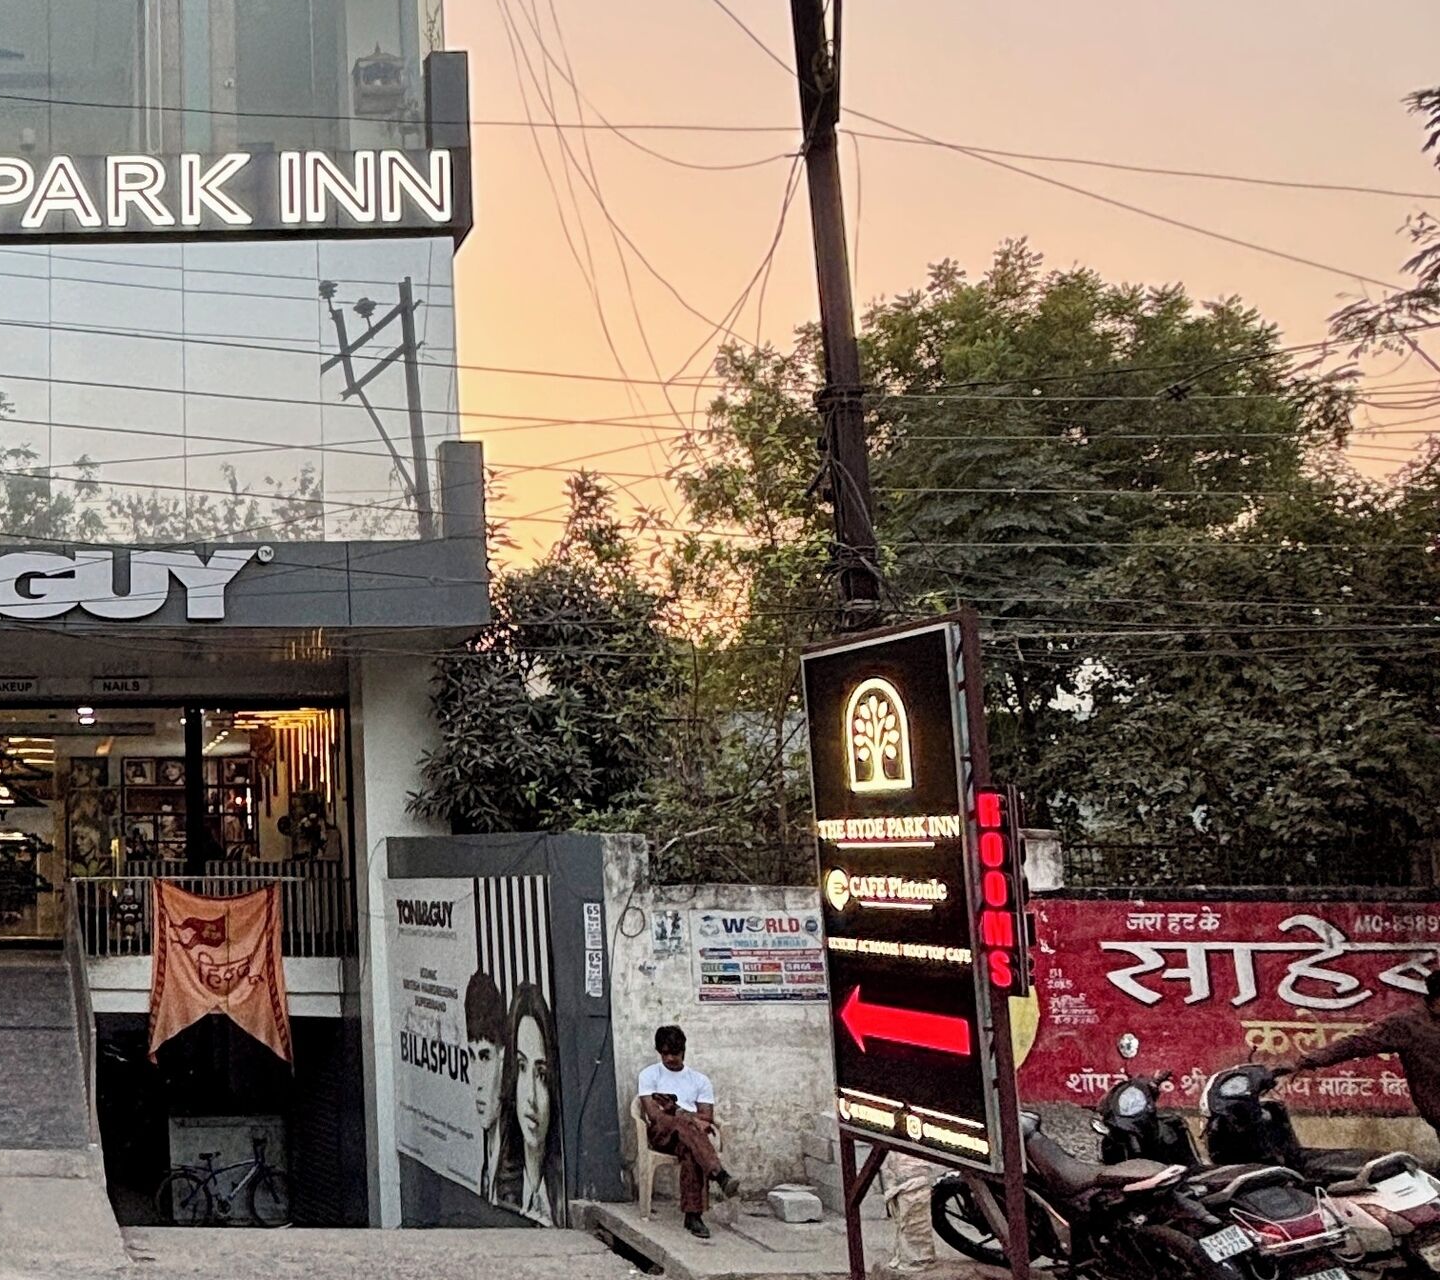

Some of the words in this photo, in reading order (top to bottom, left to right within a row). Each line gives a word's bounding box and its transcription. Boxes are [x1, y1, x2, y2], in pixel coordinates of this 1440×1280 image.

[277, 148, 453, 224] INN
[102, 681, 140, 692] NAILS
[818, 820, 845, 839] THE
[846, 818, 885, 839] HYDE
[886, 817, 927, 838] PARK
[928, 815, 959, 837] INN
[849, 877, 887, 897] CAFE
[888, 877, 947, 900] Platonic
[977, 792, 1013, 987] ROOMS
[1240, 1009, 1372, 1055] कले
[400, 1031, 470, 1084] BILASPUR
